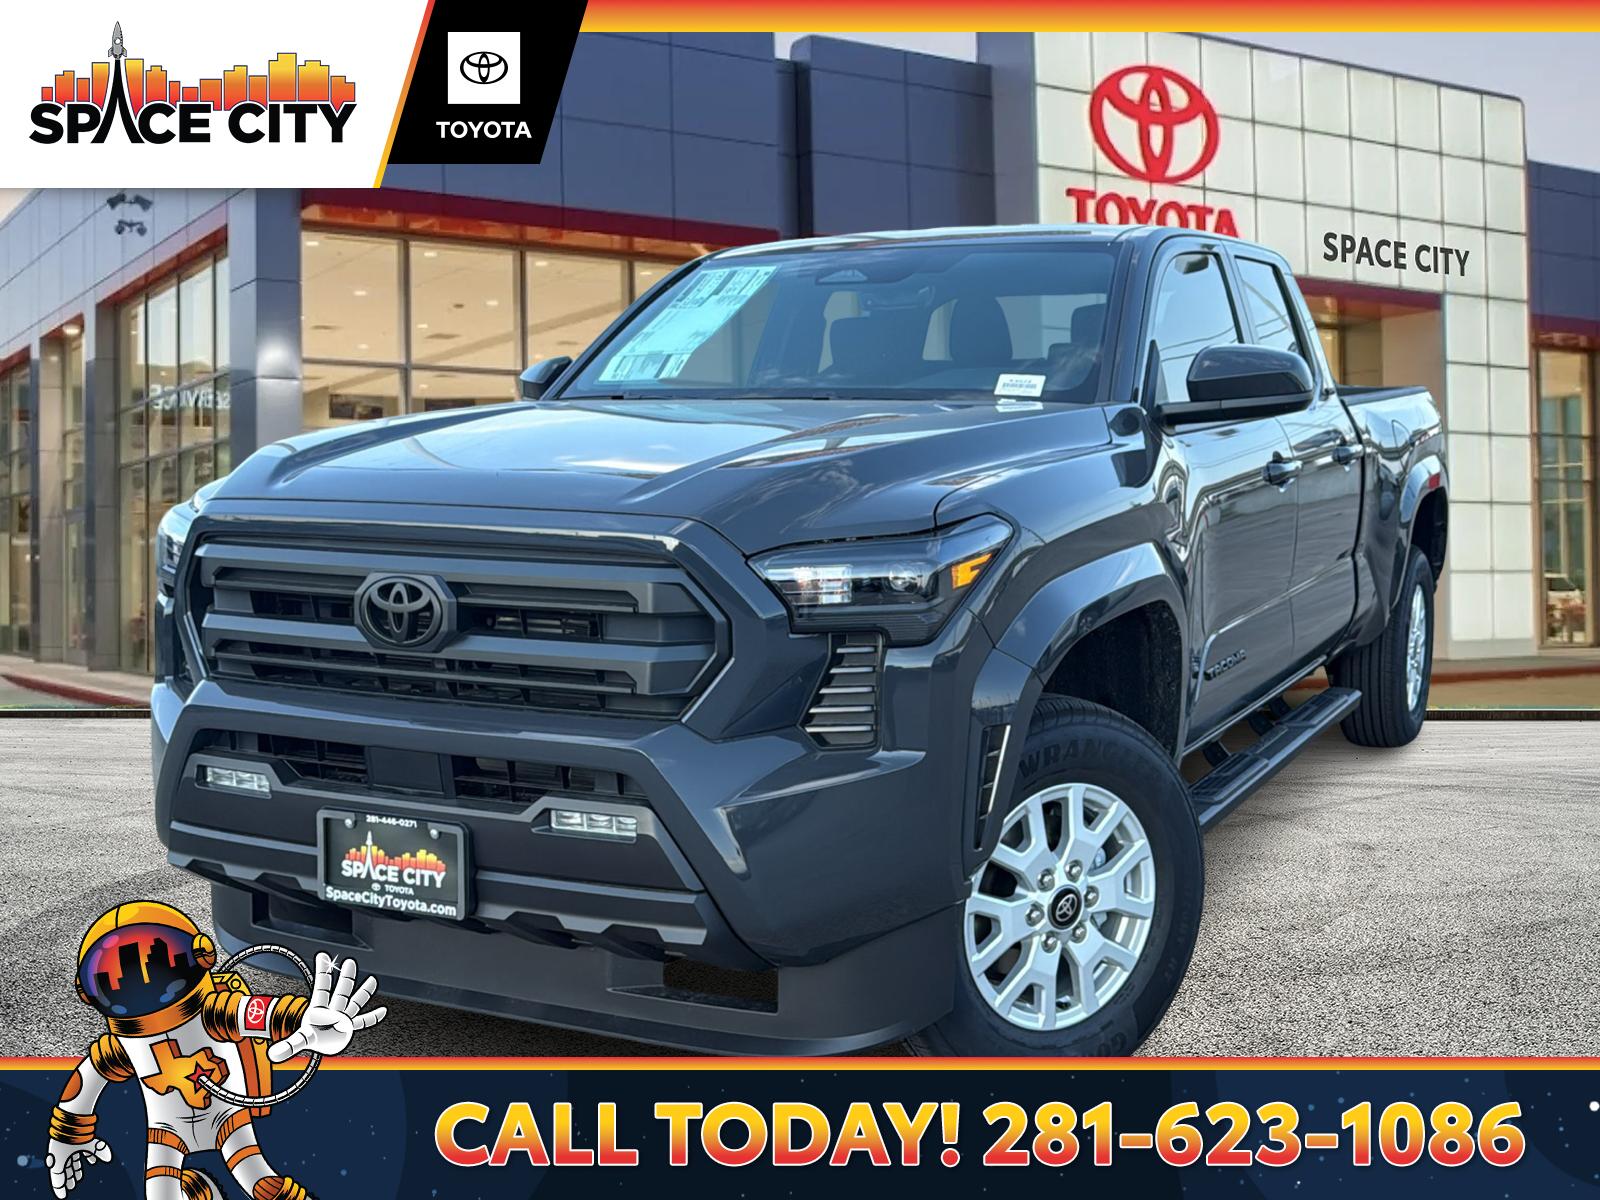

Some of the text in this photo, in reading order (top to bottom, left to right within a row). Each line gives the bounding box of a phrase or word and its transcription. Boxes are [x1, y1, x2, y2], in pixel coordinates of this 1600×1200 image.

[1065, 188, 1239, 238] TOYOTA
[1323, 231, 1470, 277] SPACE CITY
[341, 855, 446, 889] SPACE CITY
[325, 885, 457, 917] SpaceCityToyota.com
[384, 884, 414, 896] TOYOTA
